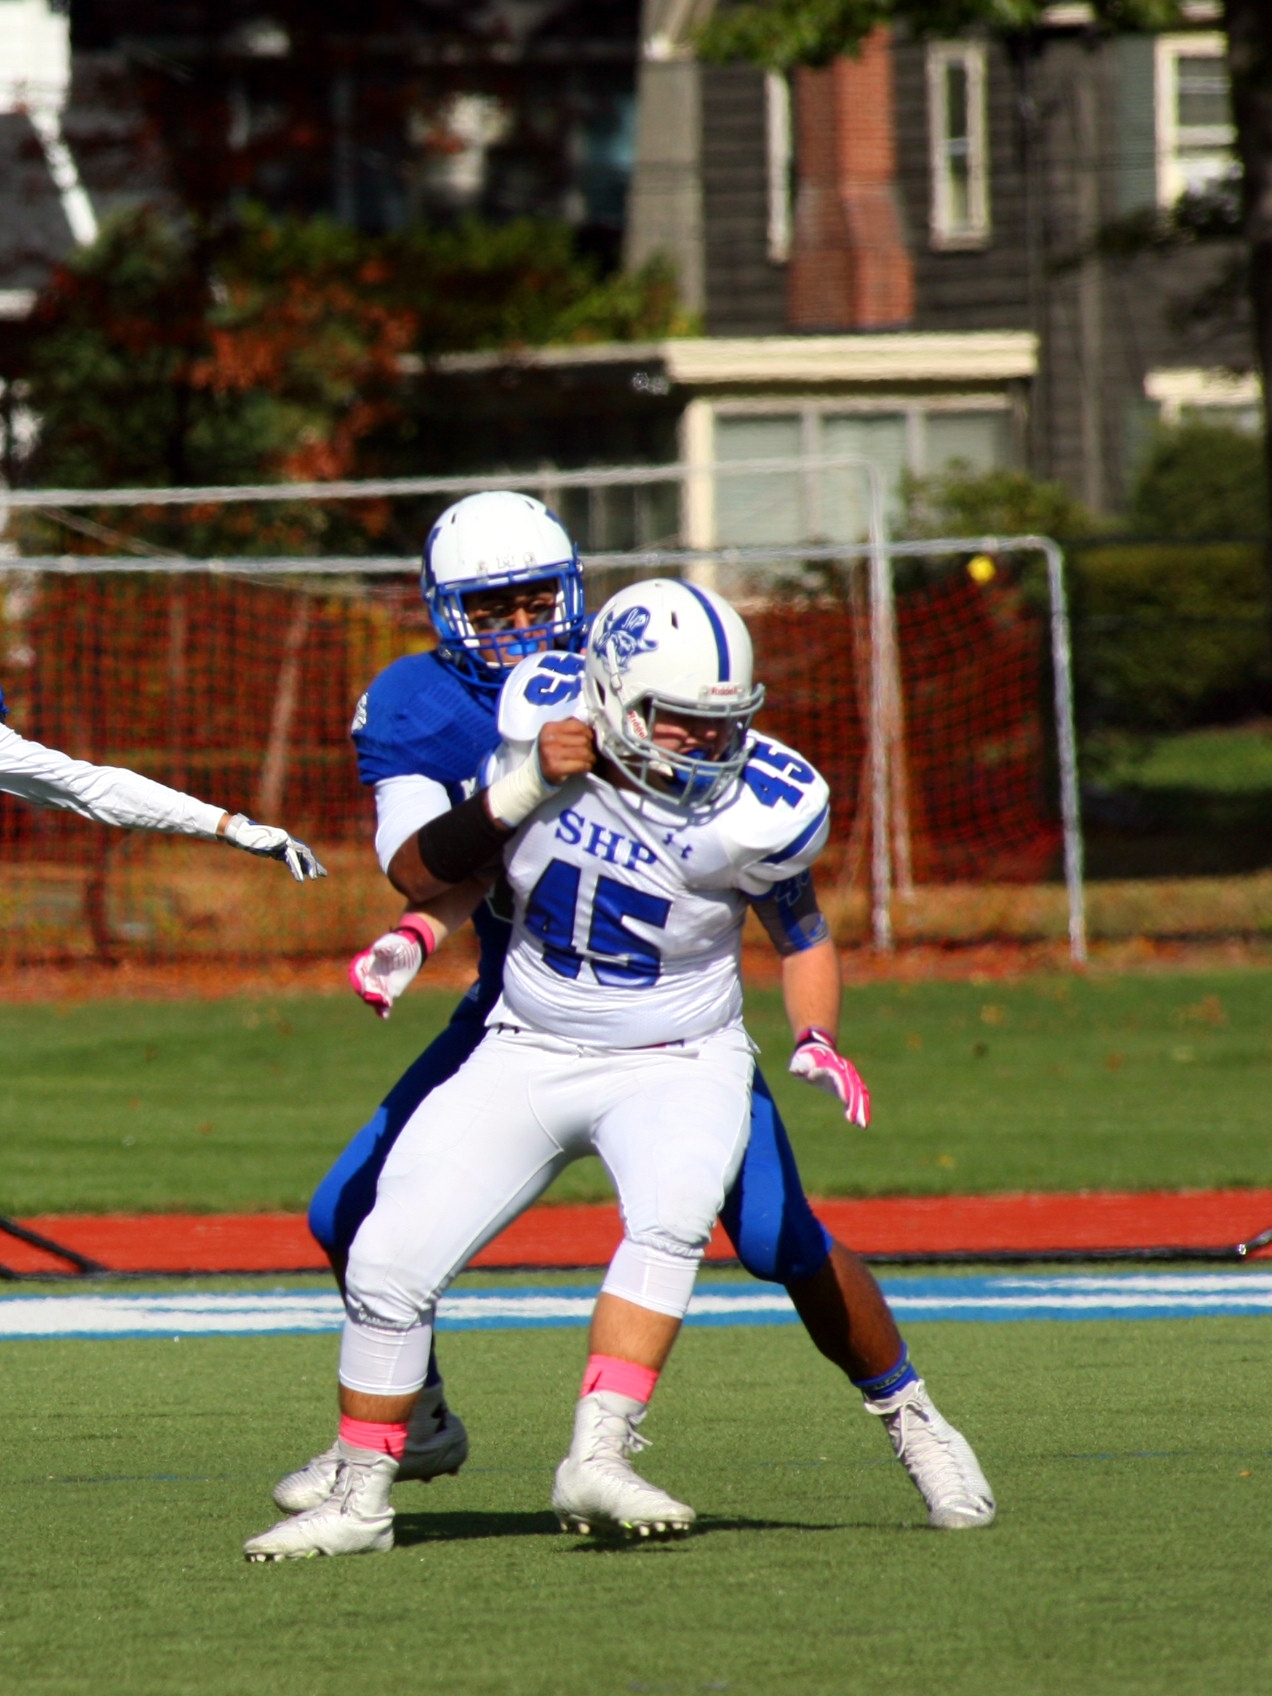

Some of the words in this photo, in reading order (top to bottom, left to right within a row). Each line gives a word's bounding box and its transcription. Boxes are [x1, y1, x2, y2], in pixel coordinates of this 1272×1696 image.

[745, 741, 816, 809] 45
[555, 808, 659, 873] SHP
[524, 857, 674, 987] 45
